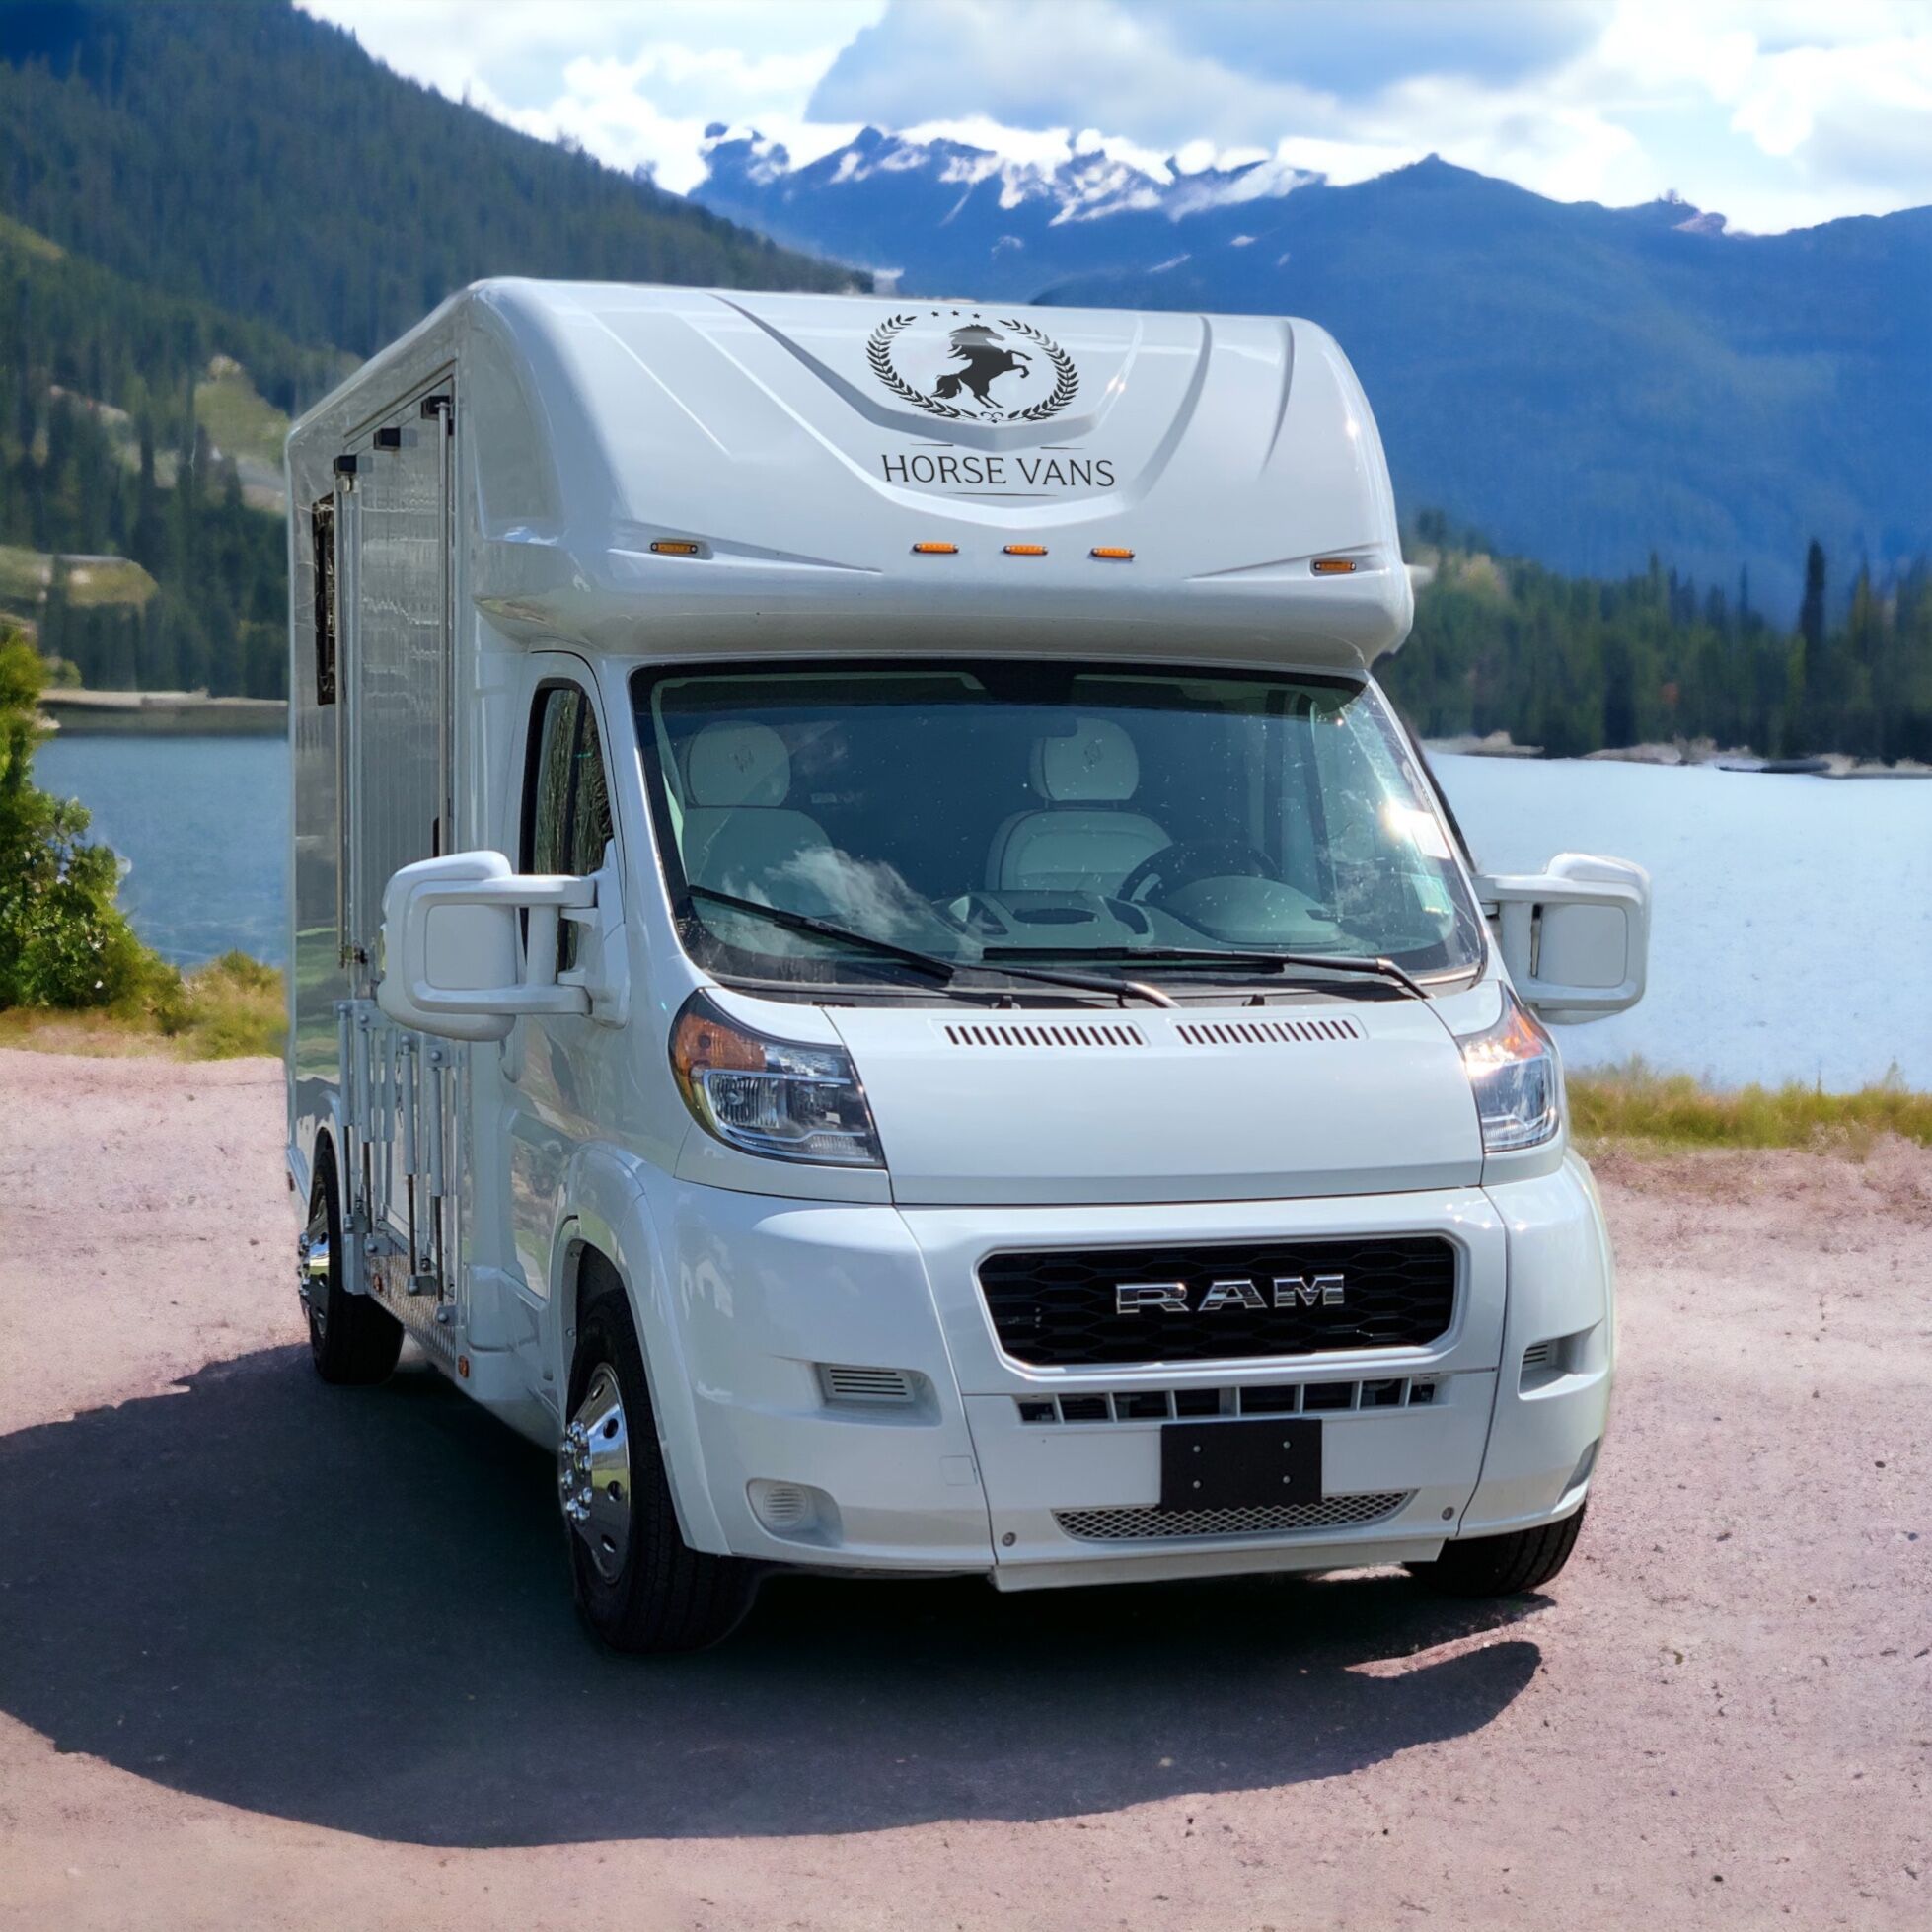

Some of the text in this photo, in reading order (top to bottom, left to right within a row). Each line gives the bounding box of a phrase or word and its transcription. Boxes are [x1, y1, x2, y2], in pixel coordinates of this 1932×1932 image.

[881, 455, 1115, 487] HORSE VANS
[1116, 1274, 1345, 1315] RAM
